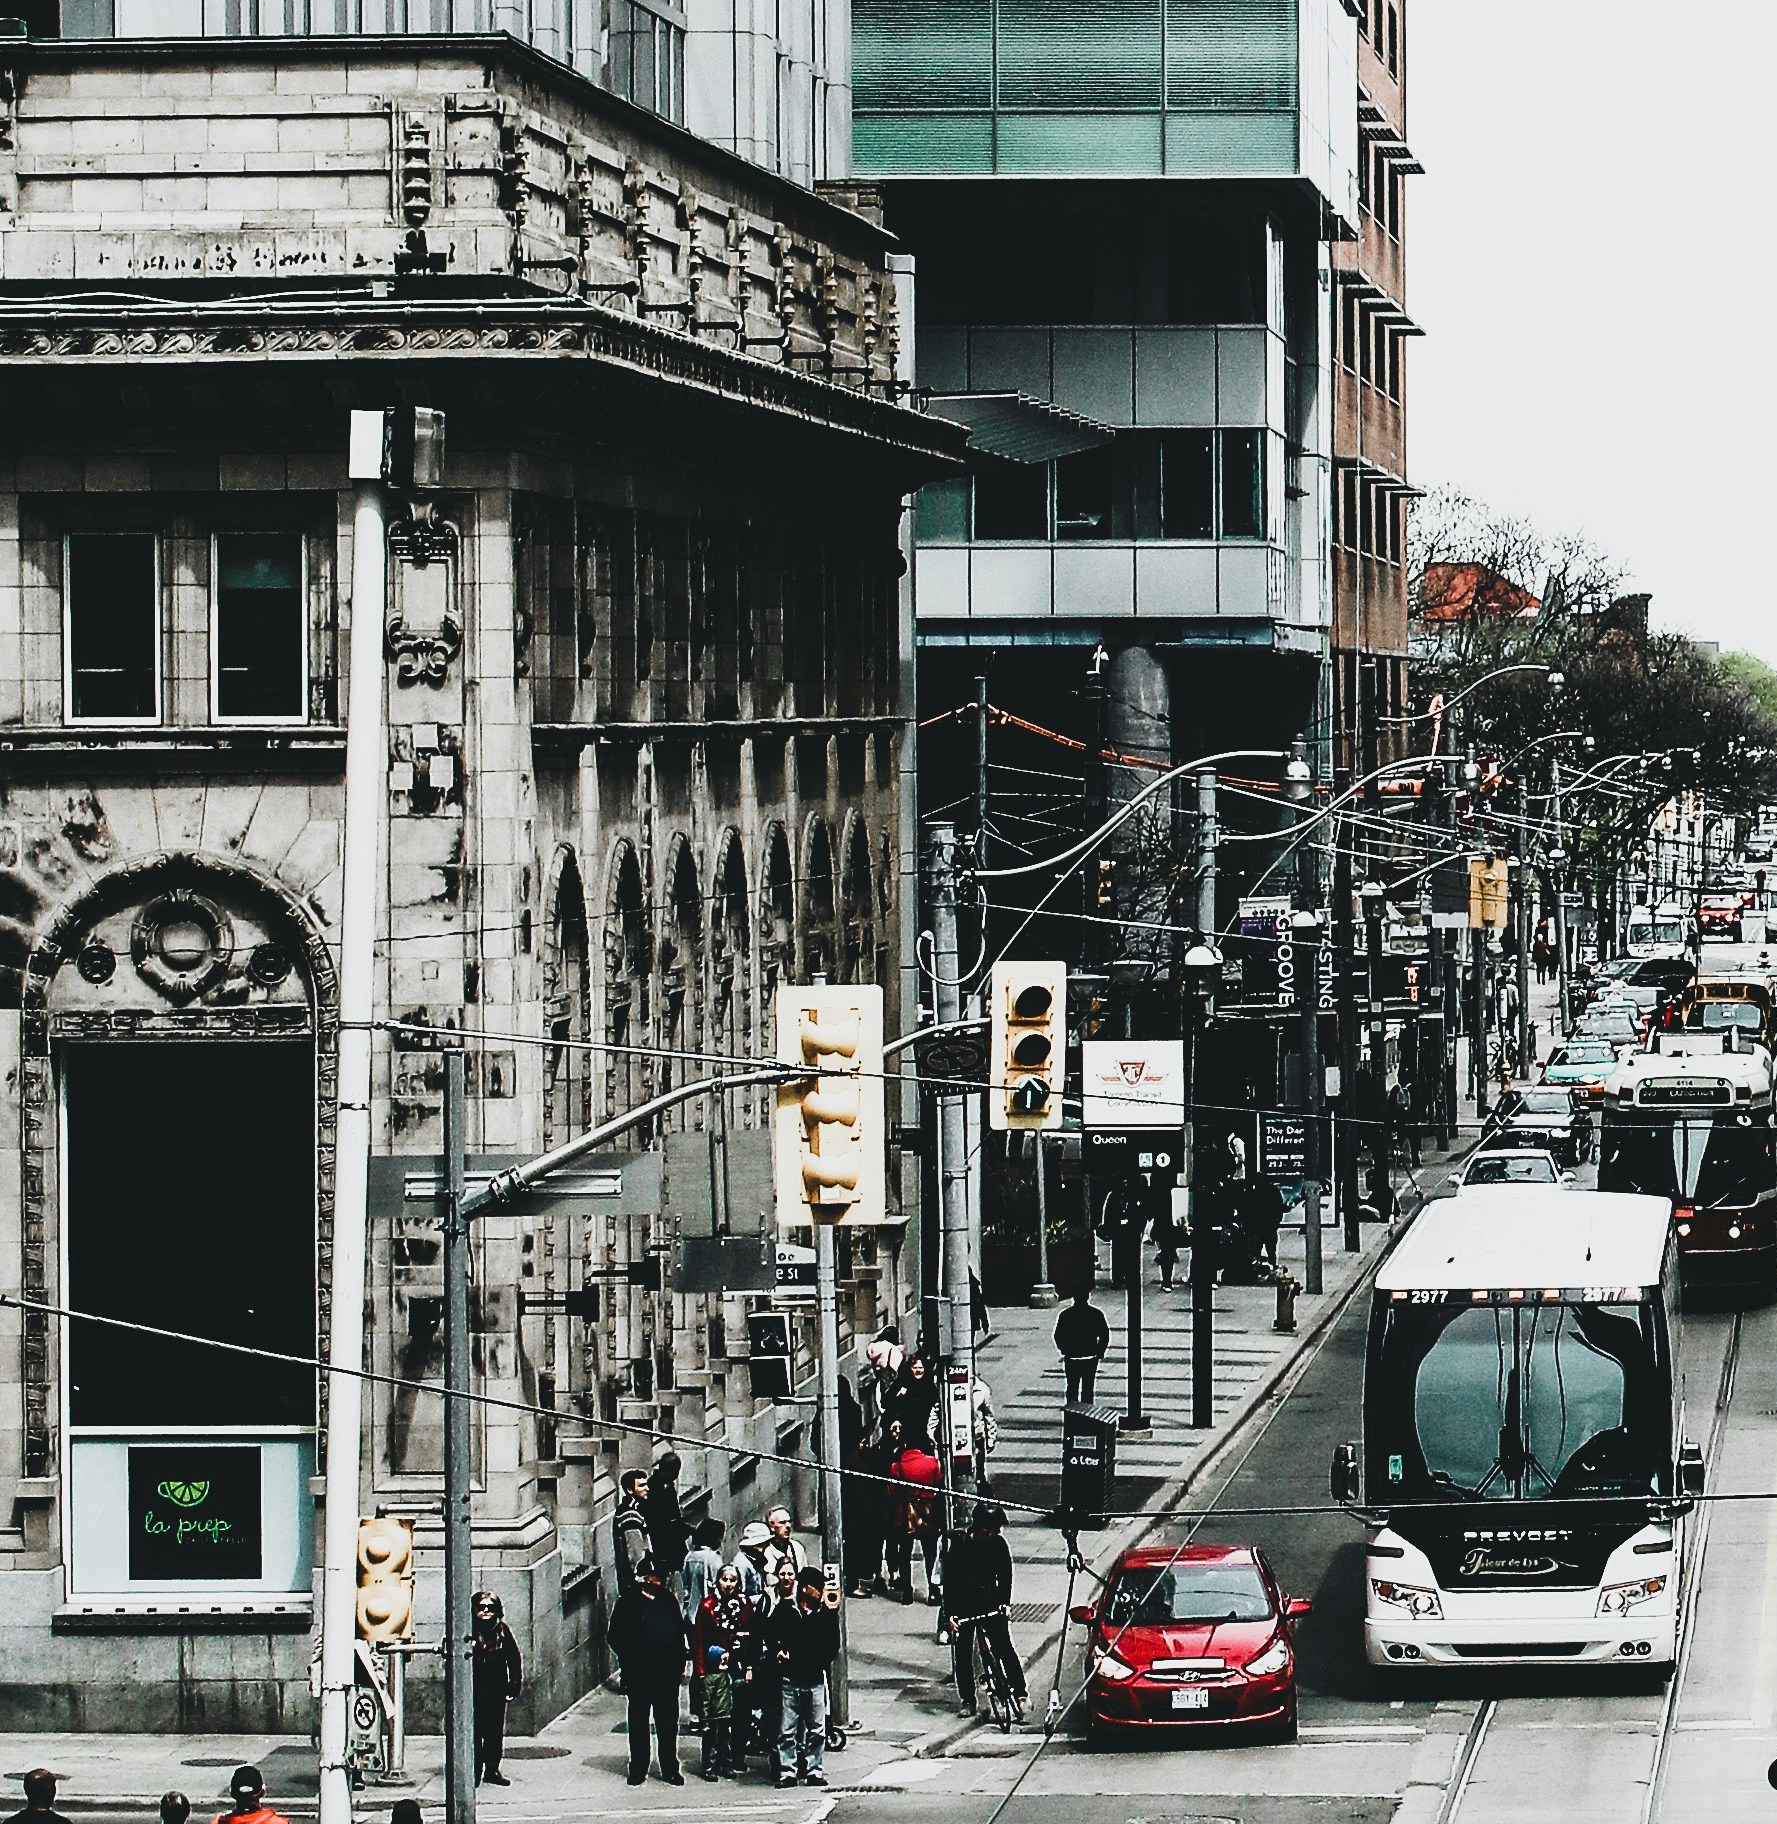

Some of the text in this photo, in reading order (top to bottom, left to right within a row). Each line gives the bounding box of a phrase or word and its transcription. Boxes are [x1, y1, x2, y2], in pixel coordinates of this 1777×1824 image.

[1276, 914, 1295, 1008] GROOVE
[1318, 923, 1334, 1009] TASTING
[1092, 1135, 1127, 1145] Queen
[1411, 1290, 1448, 1304] 2977
[145, 1511, 232, 1544] la prep
